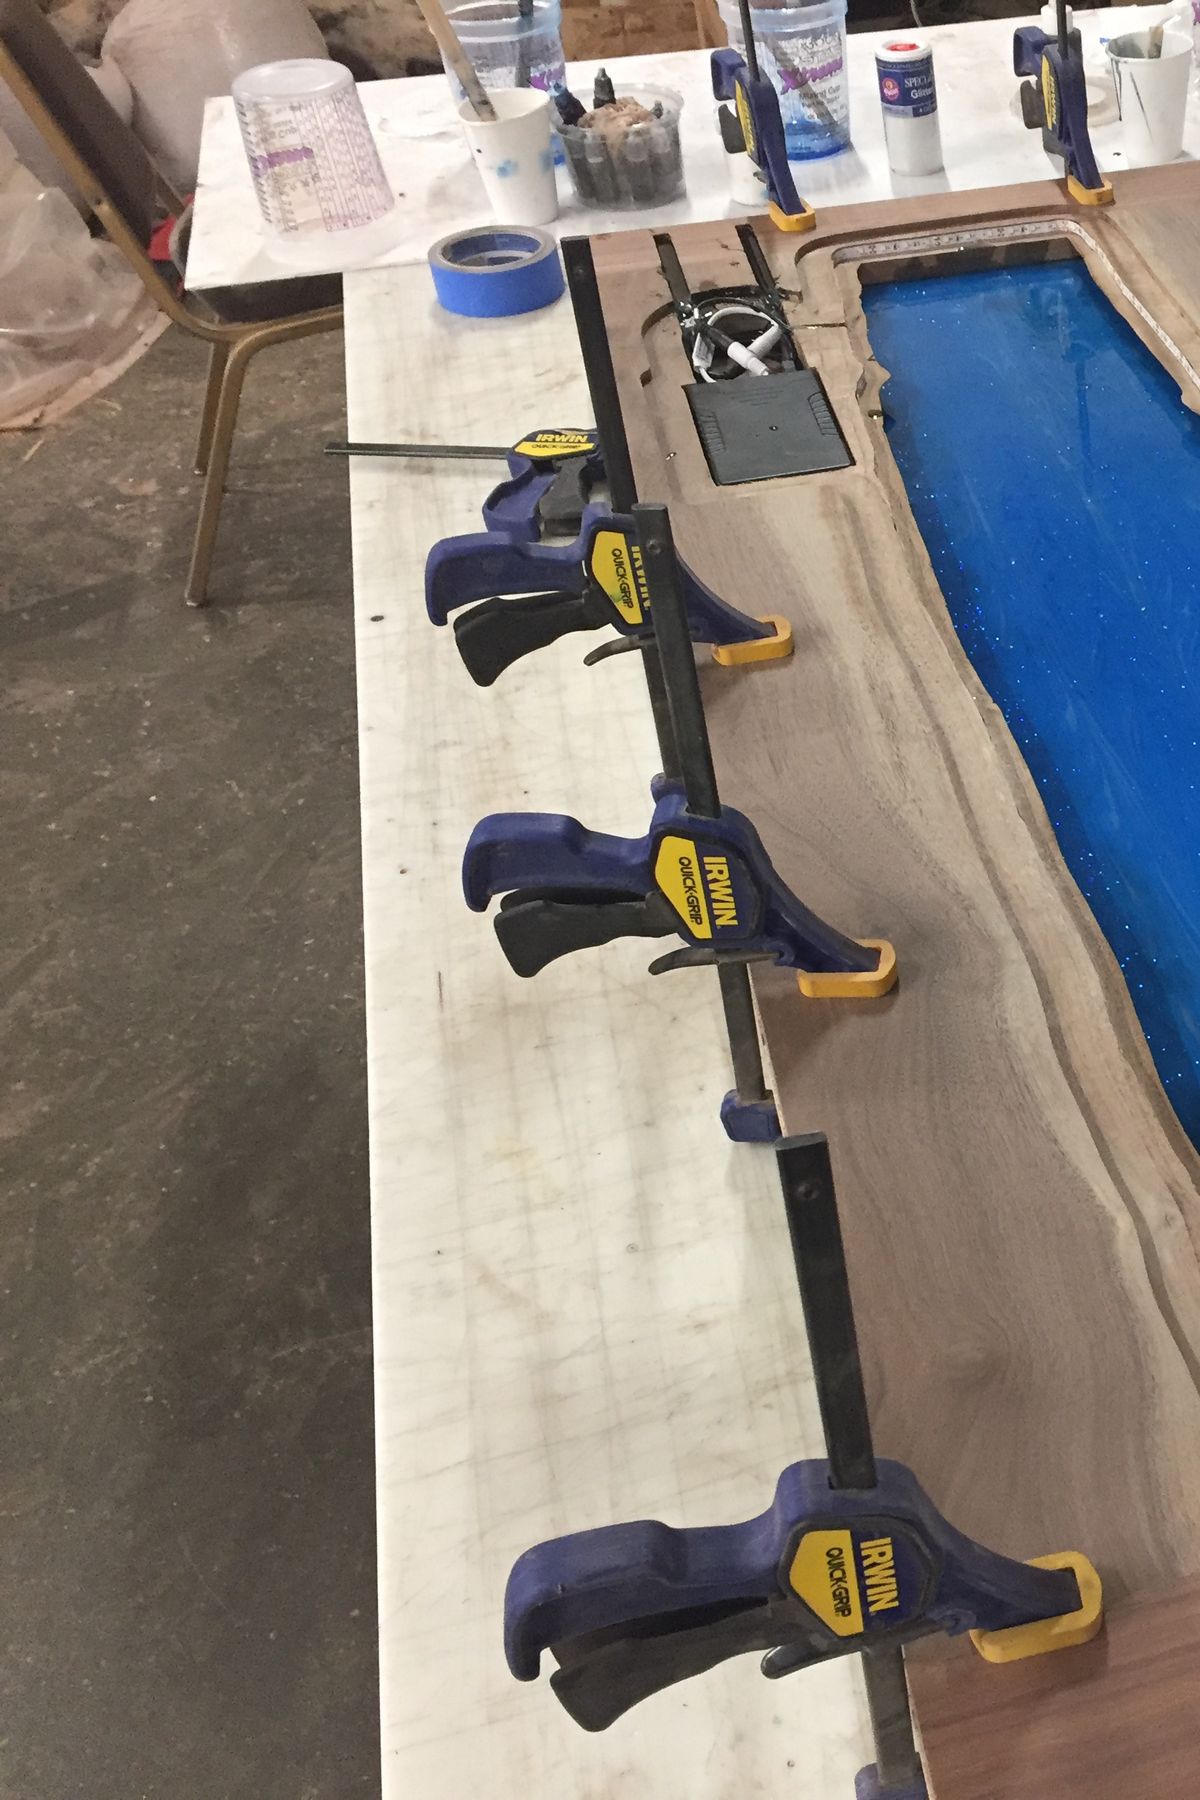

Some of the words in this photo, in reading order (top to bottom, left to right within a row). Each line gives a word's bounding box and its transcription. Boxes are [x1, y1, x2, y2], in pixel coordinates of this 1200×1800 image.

[535, 433, 588, 443] IRWIN
[703, 856, 738, 926] IRWIN
[860, 1537, 900, 1613] IRWIN
